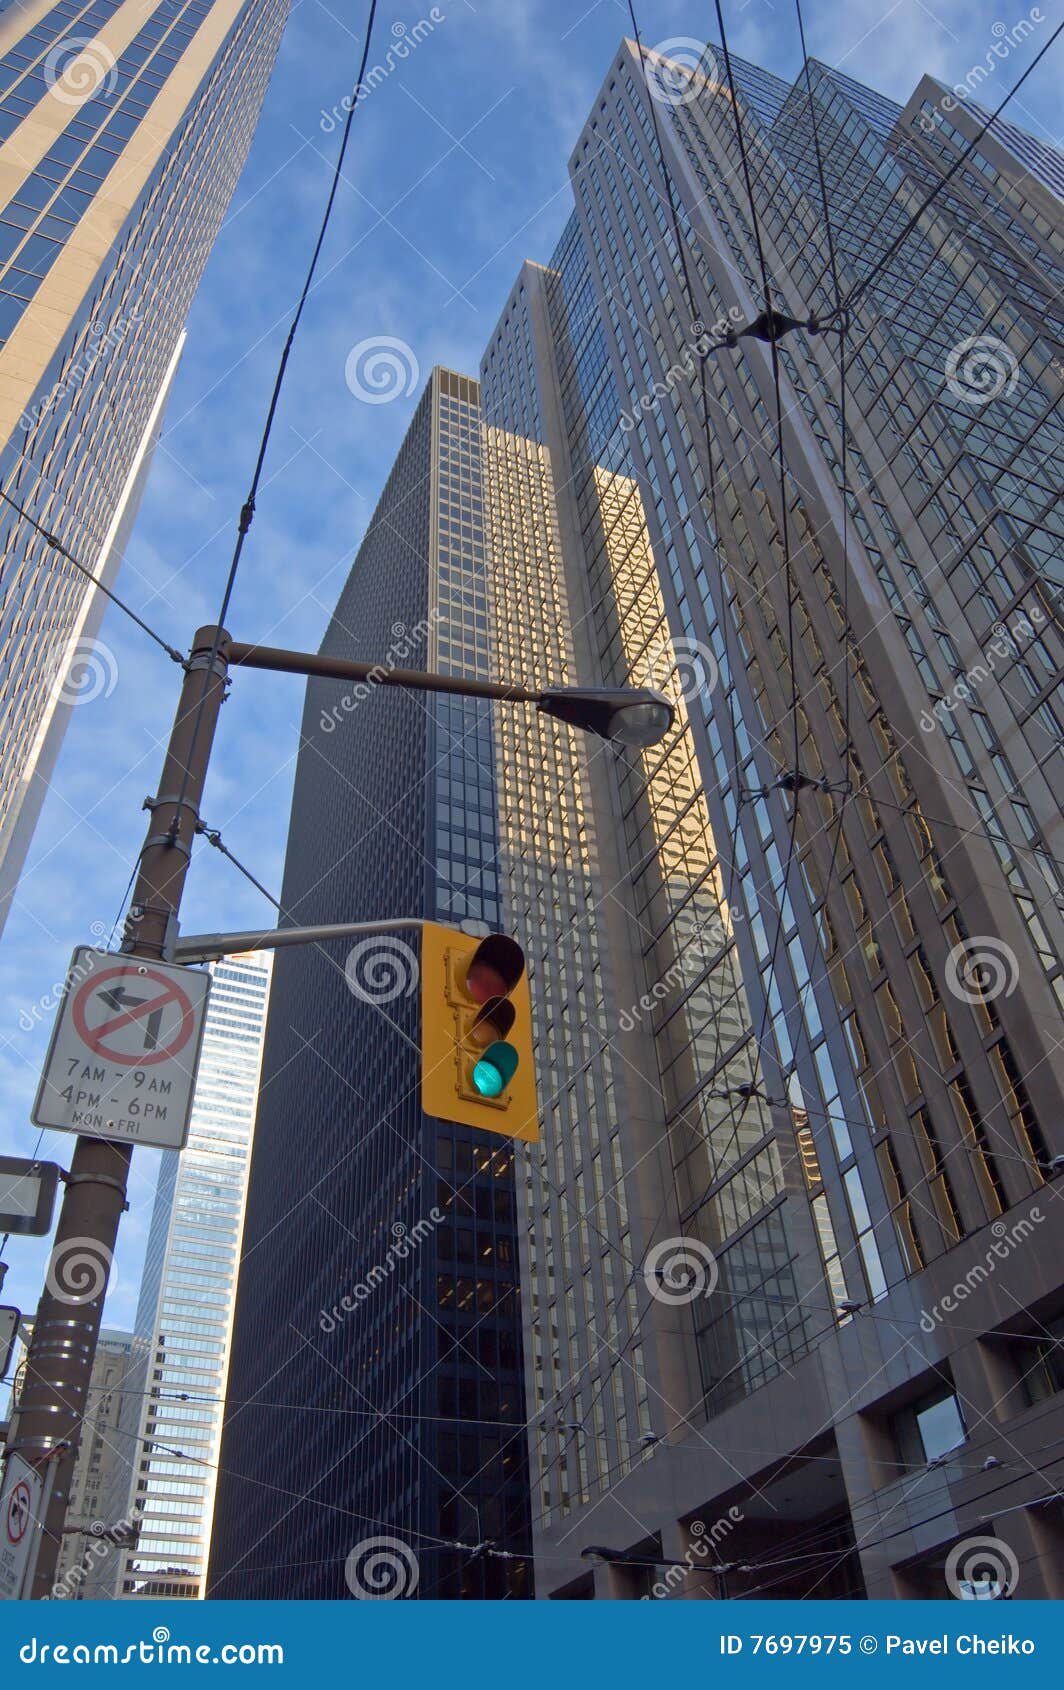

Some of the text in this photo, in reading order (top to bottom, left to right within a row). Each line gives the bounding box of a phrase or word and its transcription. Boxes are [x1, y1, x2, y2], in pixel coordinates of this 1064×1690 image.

[67, 1058, 105, 1083] 7AM
[134, 1071, 172, 1094] 9AM
[60, 1084, 100, 1108] 4PM
[128, 1098, 168, 1120] 6PM
[72, 1111, 141, 1134] MON FRI
